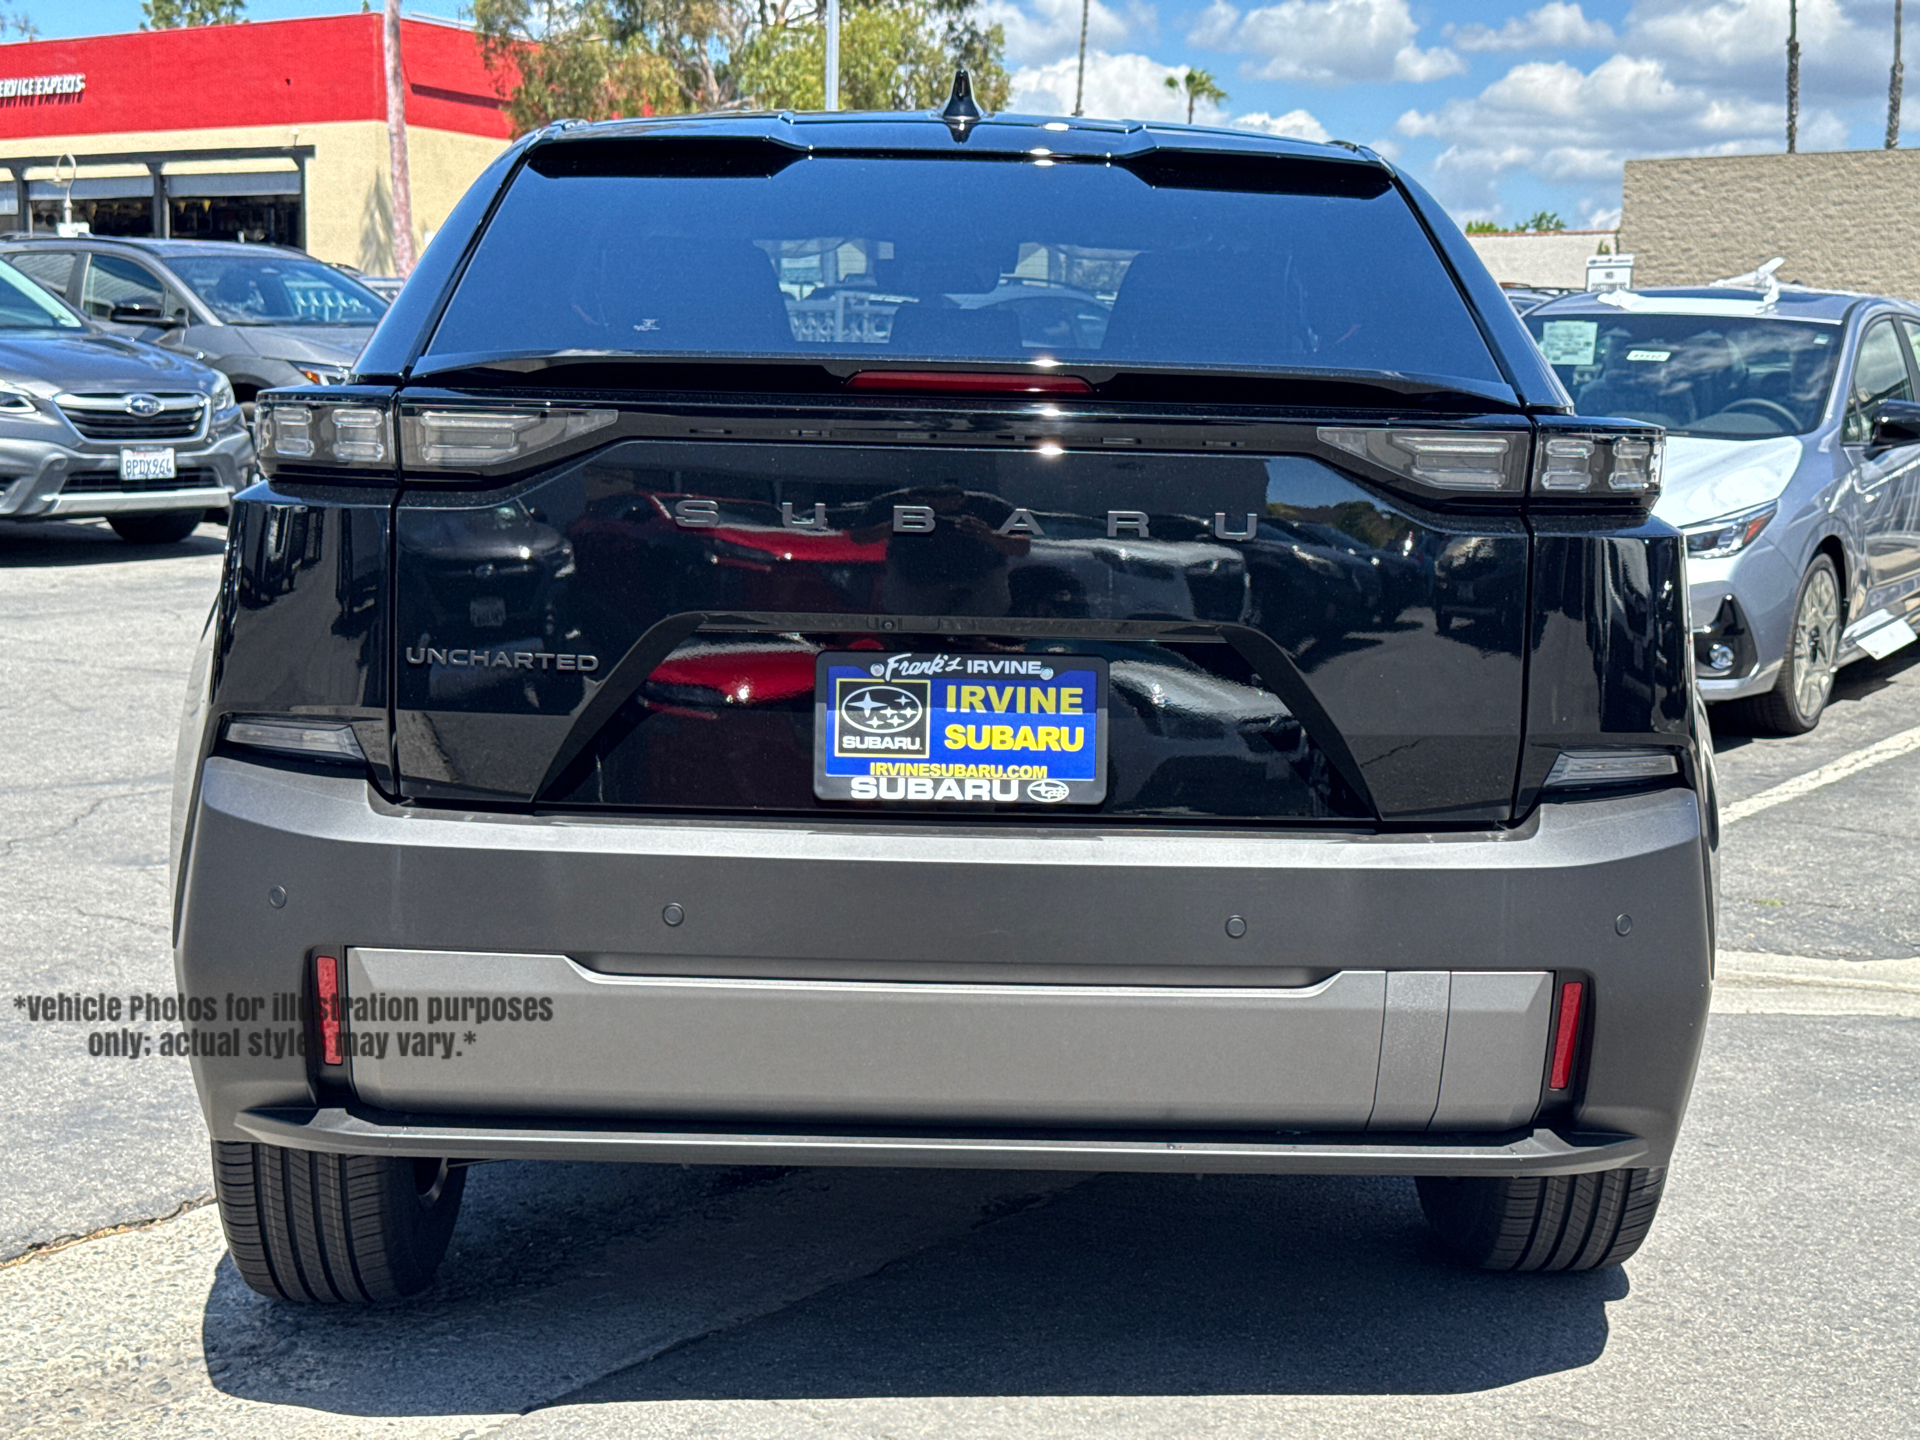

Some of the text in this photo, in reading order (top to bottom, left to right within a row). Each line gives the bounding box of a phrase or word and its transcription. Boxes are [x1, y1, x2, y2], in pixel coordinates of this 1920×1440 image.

[36, 73, 86, 95] EXPERTS
[125, 458, 172, 477] 8PDX964
[674, 499, 1259, 542] SUBARU
[406, 647, 599, 671] UNCHARTED
[885, 653, 1042, 681] Frank's IRVINE
[946, 685, 1083, 714] IRVINE
[842, 736, 921, 750] SUBARU
[944, 724, 1085, 751] SUBARU
[870, 762, 1048, 778] IRVINESUBARU.COM
[850, 777, 1019, 801] SUBARU
